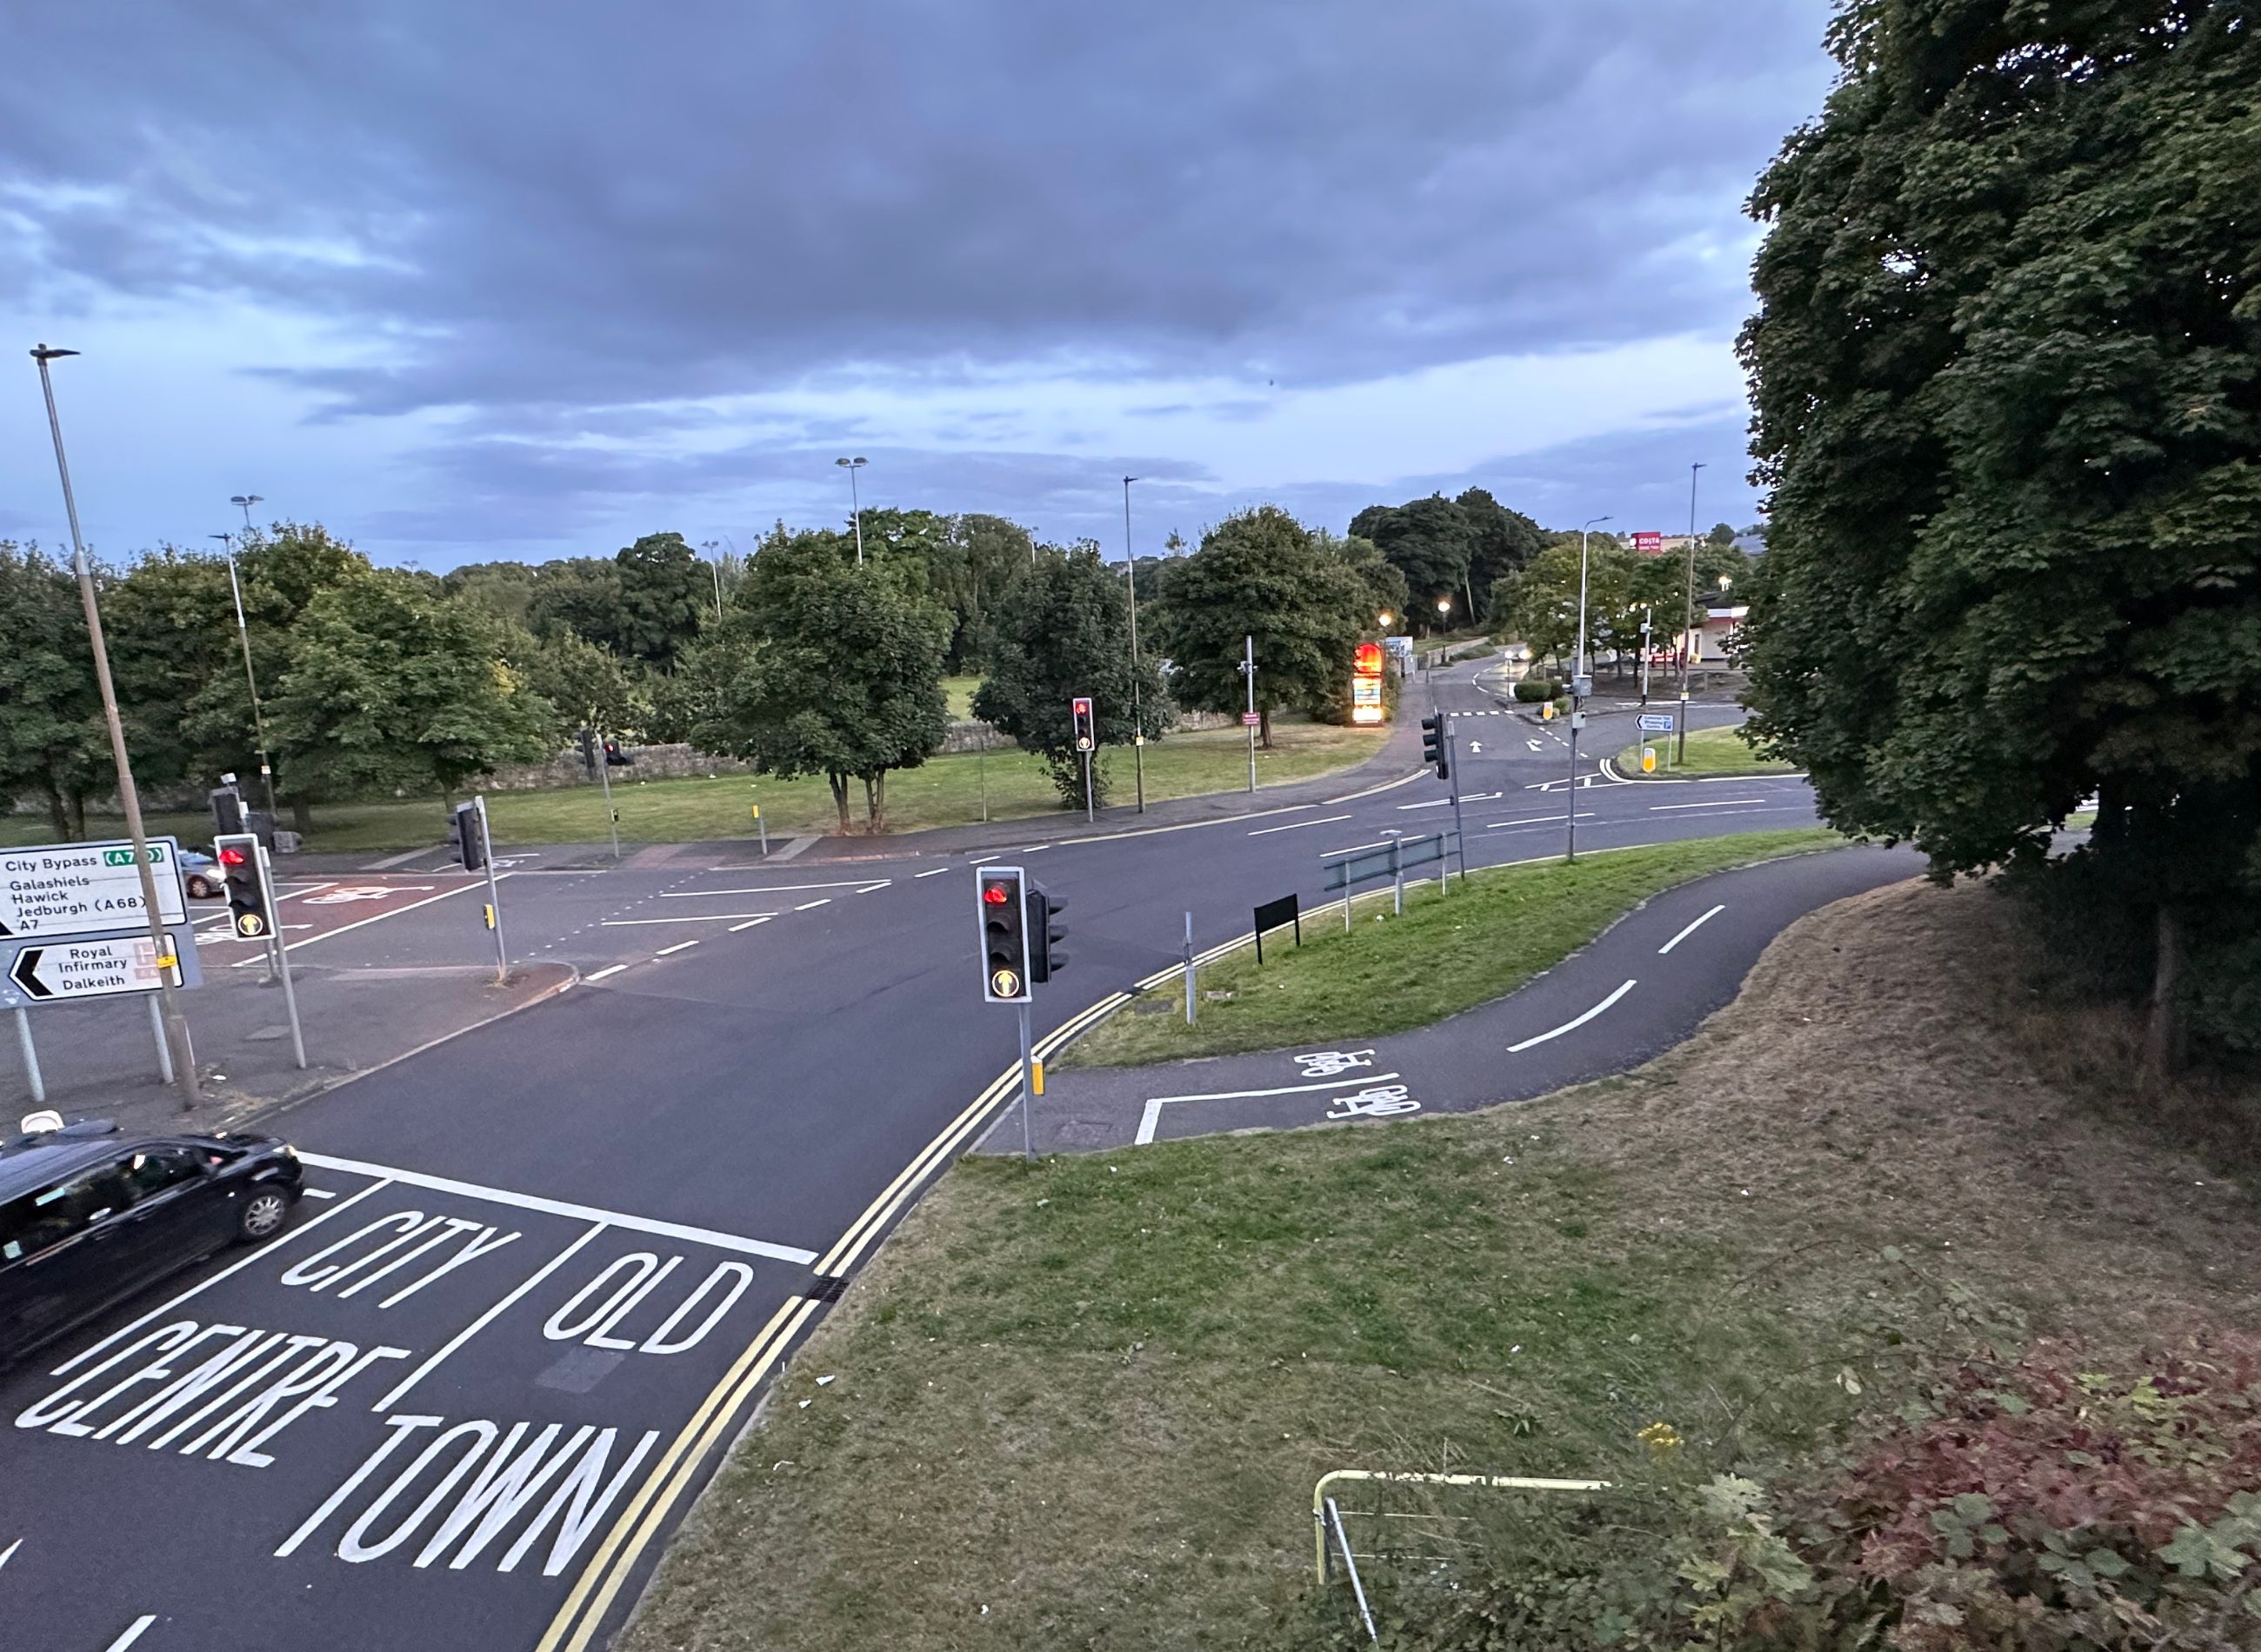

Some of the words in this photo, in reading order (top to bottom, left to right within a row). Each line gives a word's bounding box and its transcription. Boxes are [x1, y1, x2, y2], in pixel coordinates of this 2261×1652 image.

[1638, 536, 1660, 545] COSTA
[5, 861, 37, 872] City
[42, 857, 97, 870] Bypass
[105, 848, 163, 865] (A70)
[10, 876, 90, 891] Galashiels
[11, 890, 69, 904] Hawick
[17, 902, 88, 918] Jedburgh
[95, 896, 146, 912] (A68)
[20, 919, 38, 930] A7
[70, 946, 113, 959] Royal
[58, 959, 127, 973] Infirmary
[63, 976, 125, 989] Dalkeith
[281, 1209, 522, 1309] CITY
[543, 1252, 754, 1355] OLD
[14, 1321, 411, 1468] CENTRE
[273, 1414, 661, 1577] TOWN
